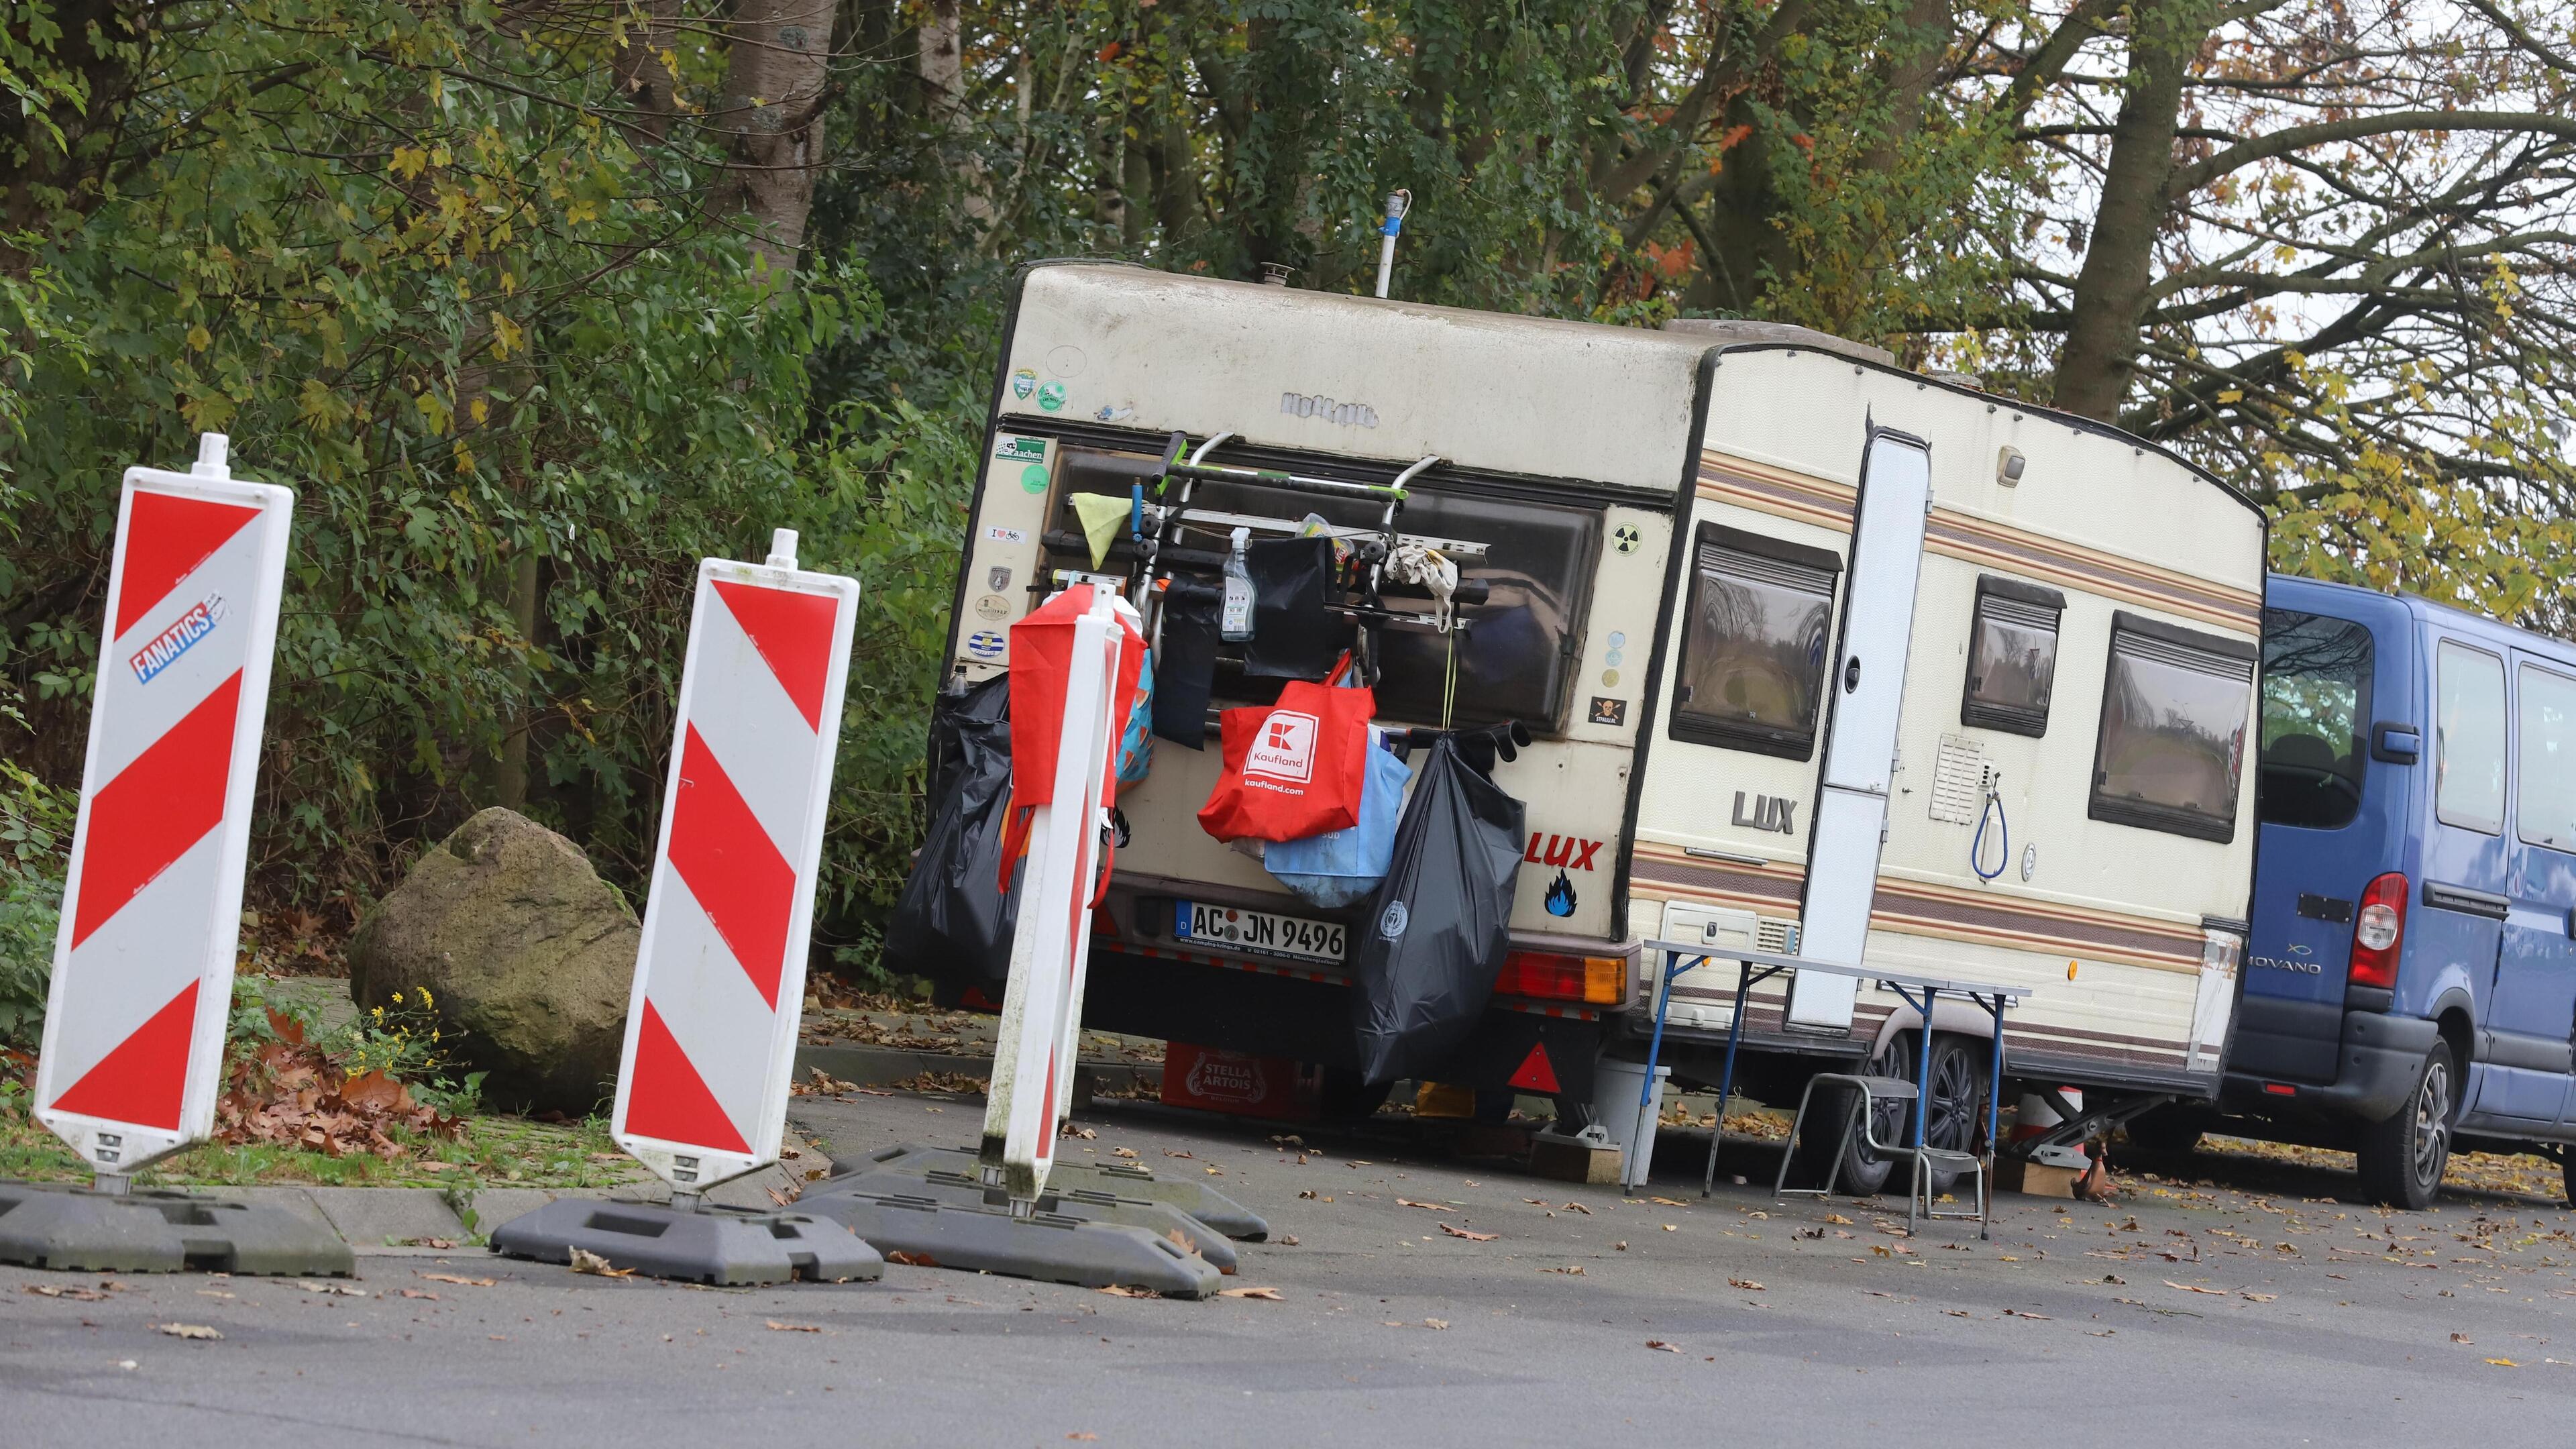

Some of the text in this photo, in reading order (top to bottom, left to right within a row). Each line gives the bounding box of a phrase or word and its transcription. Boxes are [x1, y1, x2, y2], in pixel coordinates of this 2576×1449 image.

[1014, 449, 1042, 458] aachen
[991, 529, 997, 537] I
[132, 608, 211, 680] FANATICS
[1254, 751, 1303, 767] Kaufland
[1244, 778, 1304, 796] kaufland.com
[1731, 790, 1799, 835] LUX
[1523, 832, 1604, 871] LUX
[1180, 921, 1187, 930] D
[1193, 906, 1343, 956] AC JN 9496
[1179, 938, 1241, 951] www.camping-krings.de
[1293, 954, 1340, 966] Mönchengladbach
[1205, 1063, 1251, 1079] STELLA
[1203, 1075, 1251, 1090] ARTOIS
